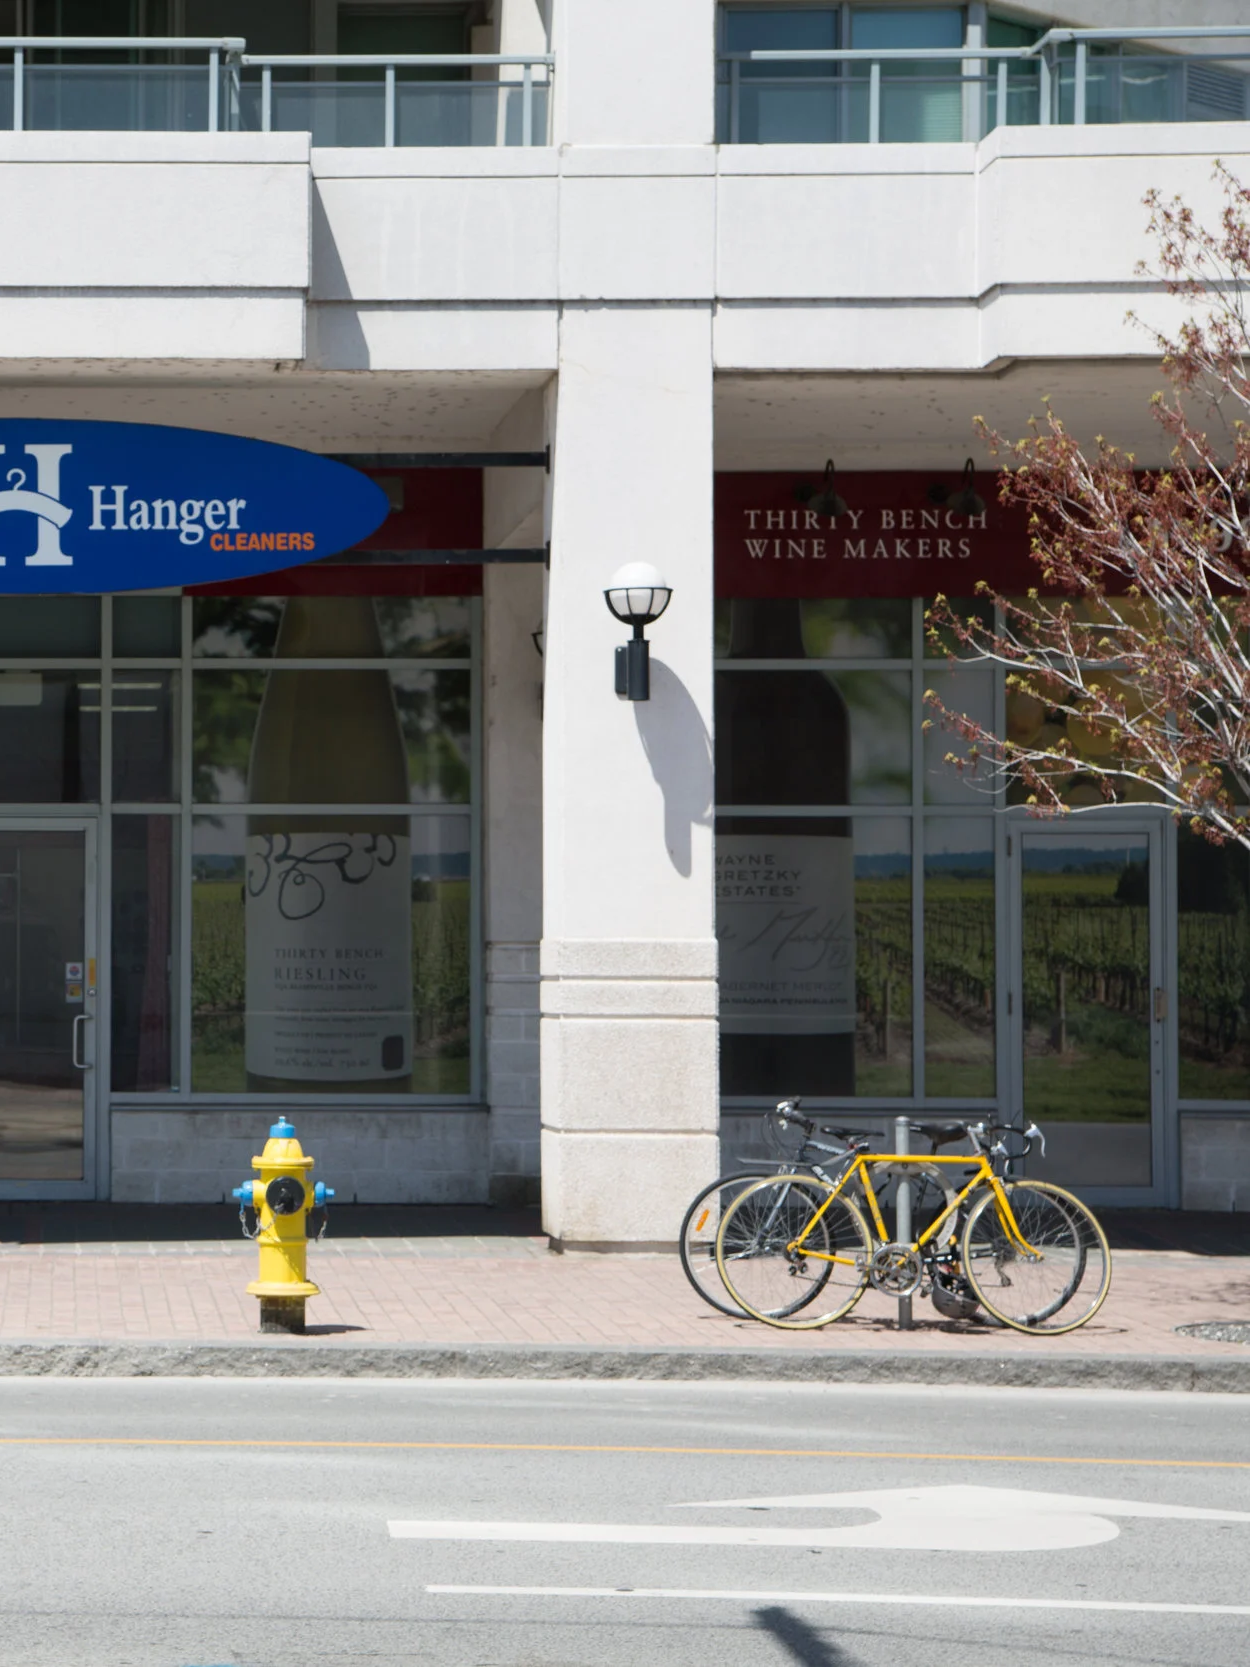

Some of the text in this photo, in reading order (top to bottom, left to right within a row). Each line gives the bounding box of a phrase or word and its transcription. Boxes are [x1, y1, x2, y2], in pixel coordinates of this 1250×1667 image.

[88, 484, 247, 545] Hanger
[209, 532, 315, 551] CLEANERS
[743, 537, 972, 560] WINE MAKERS
[335, 948, 384, 959] BENCH
[274, 967, 367, 981] RIESLING
